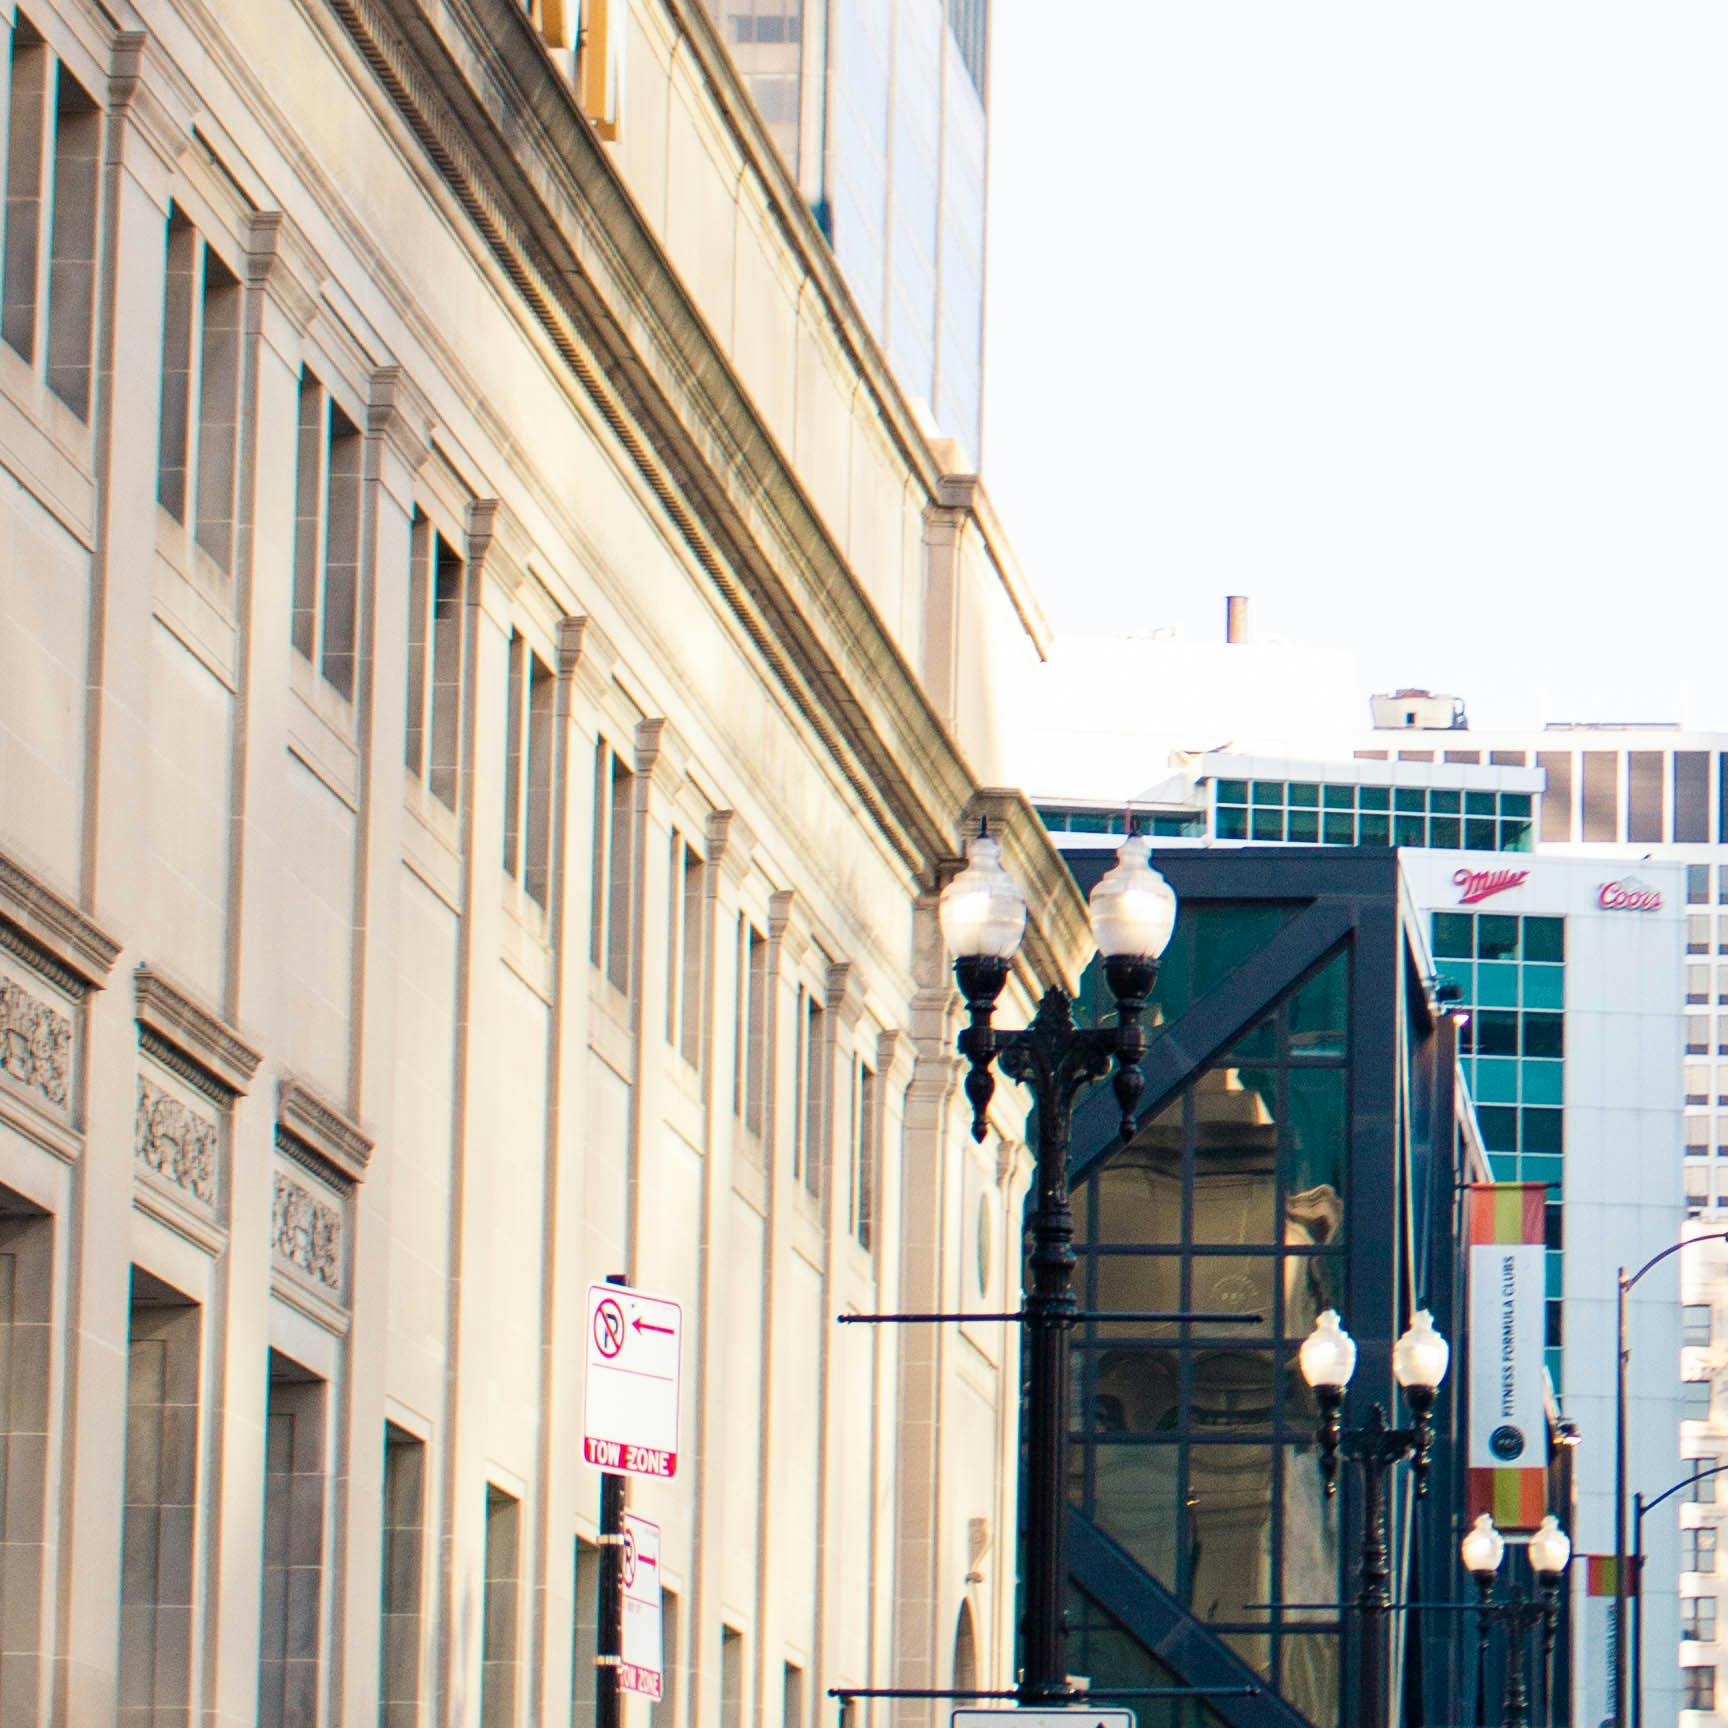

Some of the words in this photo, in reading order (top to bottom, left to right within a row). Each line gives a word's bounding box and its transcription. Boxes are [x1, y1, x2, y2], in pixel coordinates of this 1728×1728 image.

[1453, 868, 1531, 904] Miller
[1599, 880, 1663, 910] Coors
[1502, 1256, 1515, 1297] CLUBS
[1502, 1299, 1515, 1362] FORMULA
[1502, 1365, 1515, 1417] FITNESS
[588, 1438, 621, 1467] TOW
[626, 1446, 670, 1476] ZONE
